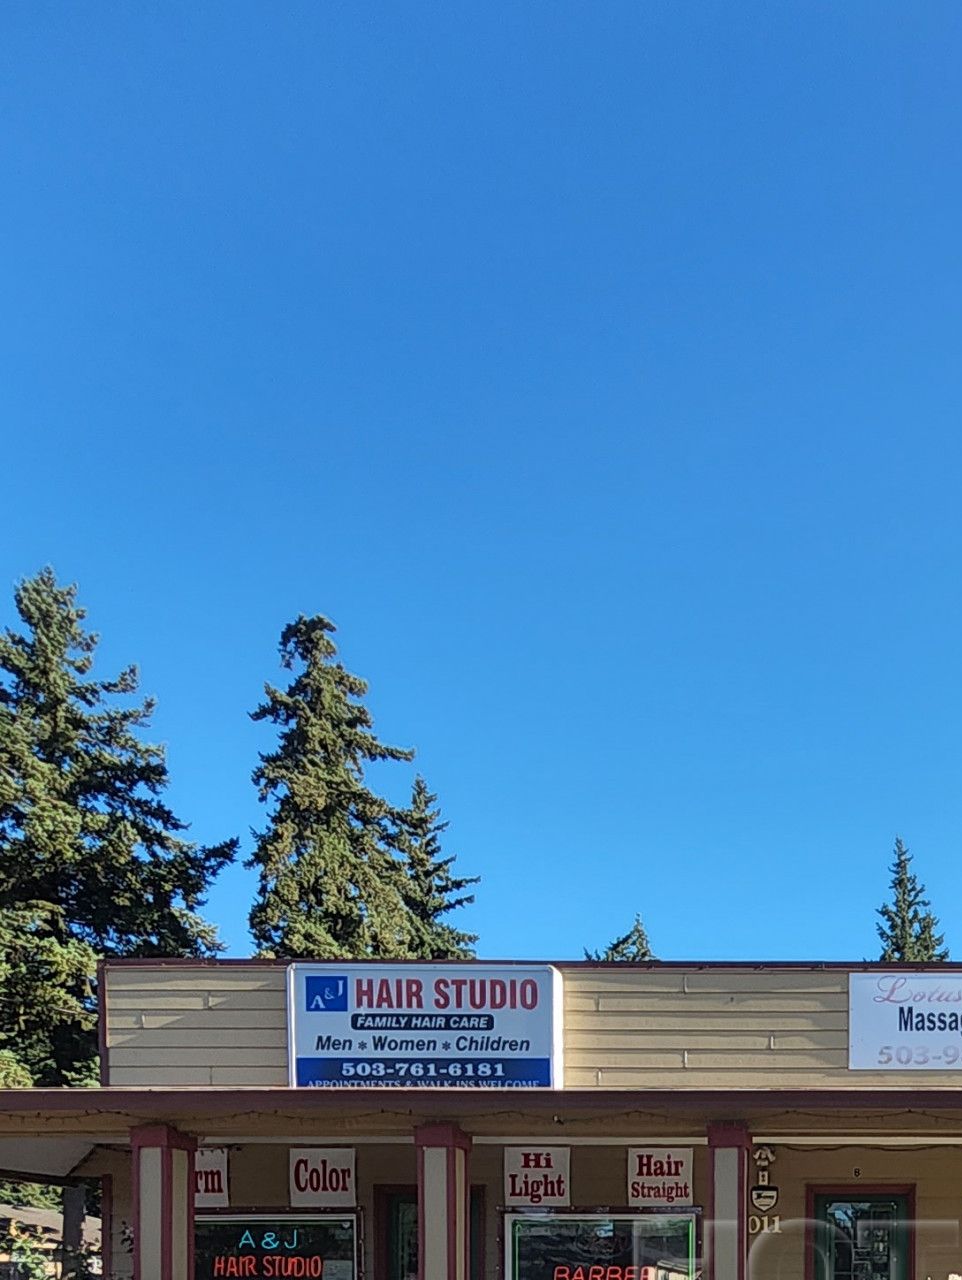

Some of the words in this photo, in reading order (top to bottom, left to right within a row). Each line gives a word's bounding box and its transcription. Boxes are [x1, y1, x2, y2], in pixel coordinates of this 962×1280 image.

[355, 978, 424, 1010] HAIR
[433, 978, 539, 1010] STUDIO
[872, 975, 962, 1005] Lotus
[356, 1016, 409, 1028] FAMILY
[411, 1016, 444, 1028] HAIR
[449, 1016, 489, 1028] CARE
[315, 1036, 352, 1051] Men
[372, 1036, 437, 1051] Women
[455, 1036, 530, 1052] Children
[341, 1062, 506, 1077] 503-761-6181
[521, 1152, 553, 1169] Hi
[636, 1153, 684, 1178] Hair
[294, 1158, 351, 1193] Color
[509, 1174, 565, 1203] Light
[631, 1181, 690, 1203] Straight
[238, 1229, 256, 1249] A
[261, 1231, 280, 1250] &
[284, 1229, 298, 1249] J
[213, 1255, 258, 1278] HAIR
[262, 1255, 322, 1278] STUDIO
